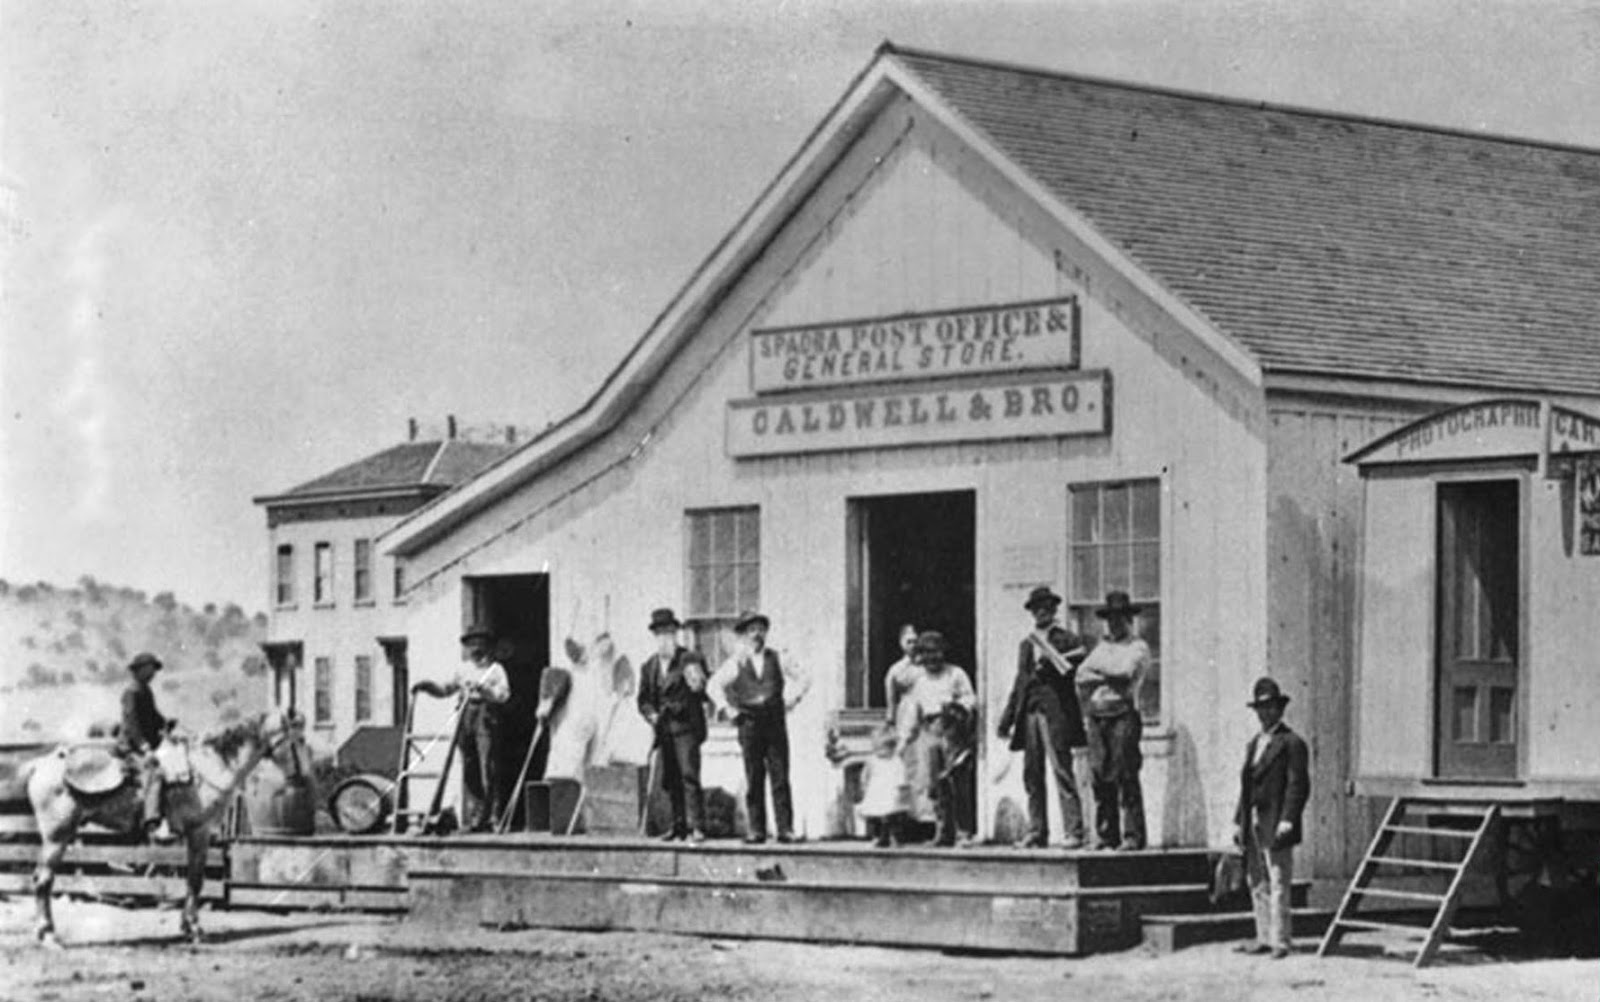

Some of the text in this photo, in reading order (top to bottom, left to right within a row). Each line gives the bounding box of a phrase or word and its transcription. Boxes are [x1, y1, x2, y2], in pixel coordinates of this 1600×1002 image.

[852, 320, 928, 351] POST
[936, 309, 1041, 343] OFFICE
[1045, 307, 1068, 333] &
[783, 337, 1024, 380] GENERAL STORE.
[753, 385, 1095, 435] CALDWELL & BRO.
